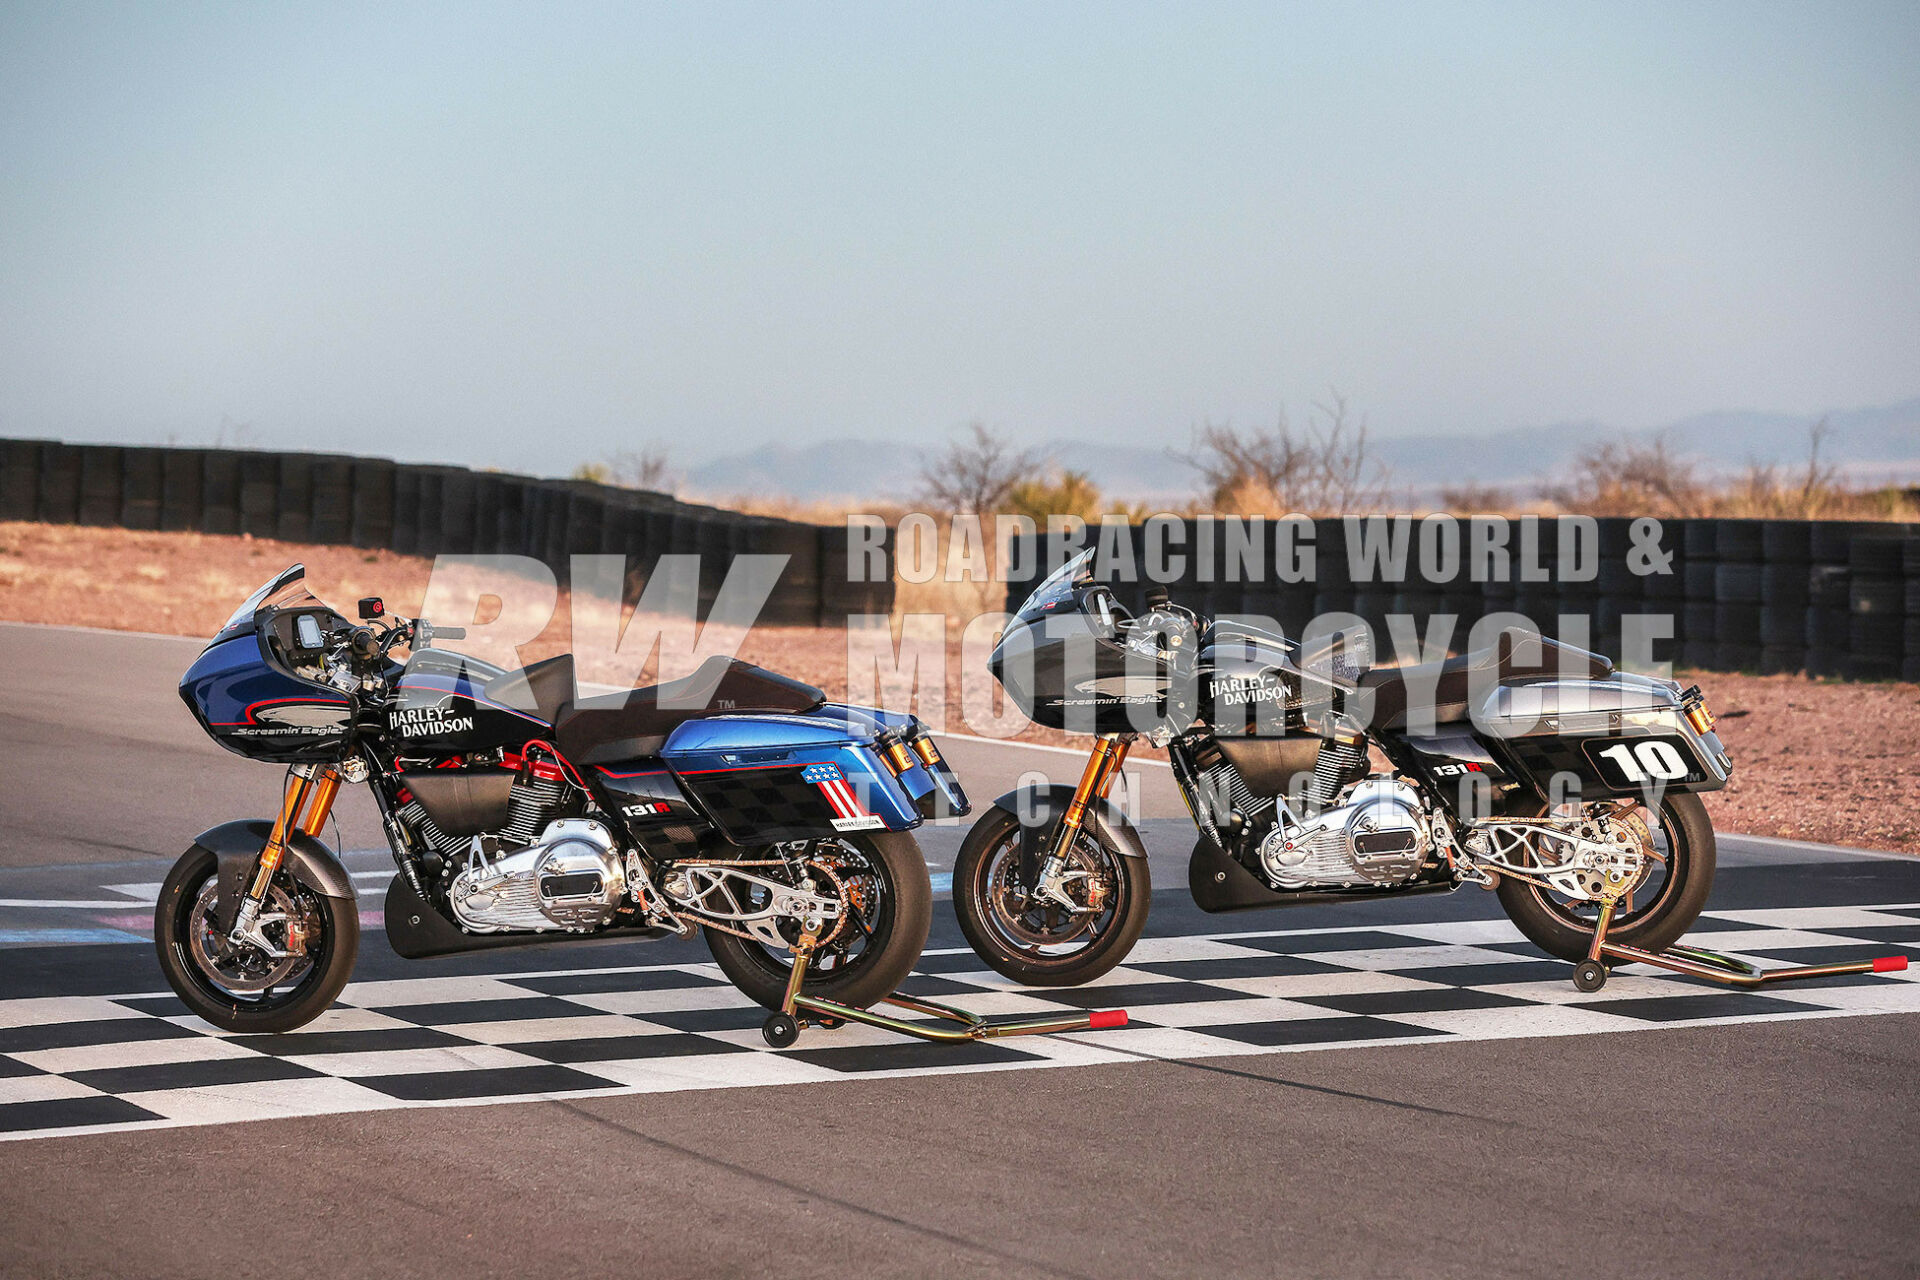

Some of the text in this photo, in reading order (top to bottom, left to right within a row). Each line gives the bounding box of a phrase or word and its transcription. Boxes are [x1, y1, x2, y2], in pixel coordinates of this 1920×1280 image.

[1209, 675, 1275, 699] HARLEY-
[1224, 684, 1292, 706] DAVIDSON
[1119, 695, 1162, 705] Eagle
[389, 706, 455, 730] HARLEY-
[402, 716, 474, 738] DAVIDSON
[301, 725, 343, 736] Eagle
[1433, 762, 1482, 777] 131R
[1598, 740, 1689, 782] 10
[621, 802, 671, 817] 131R
